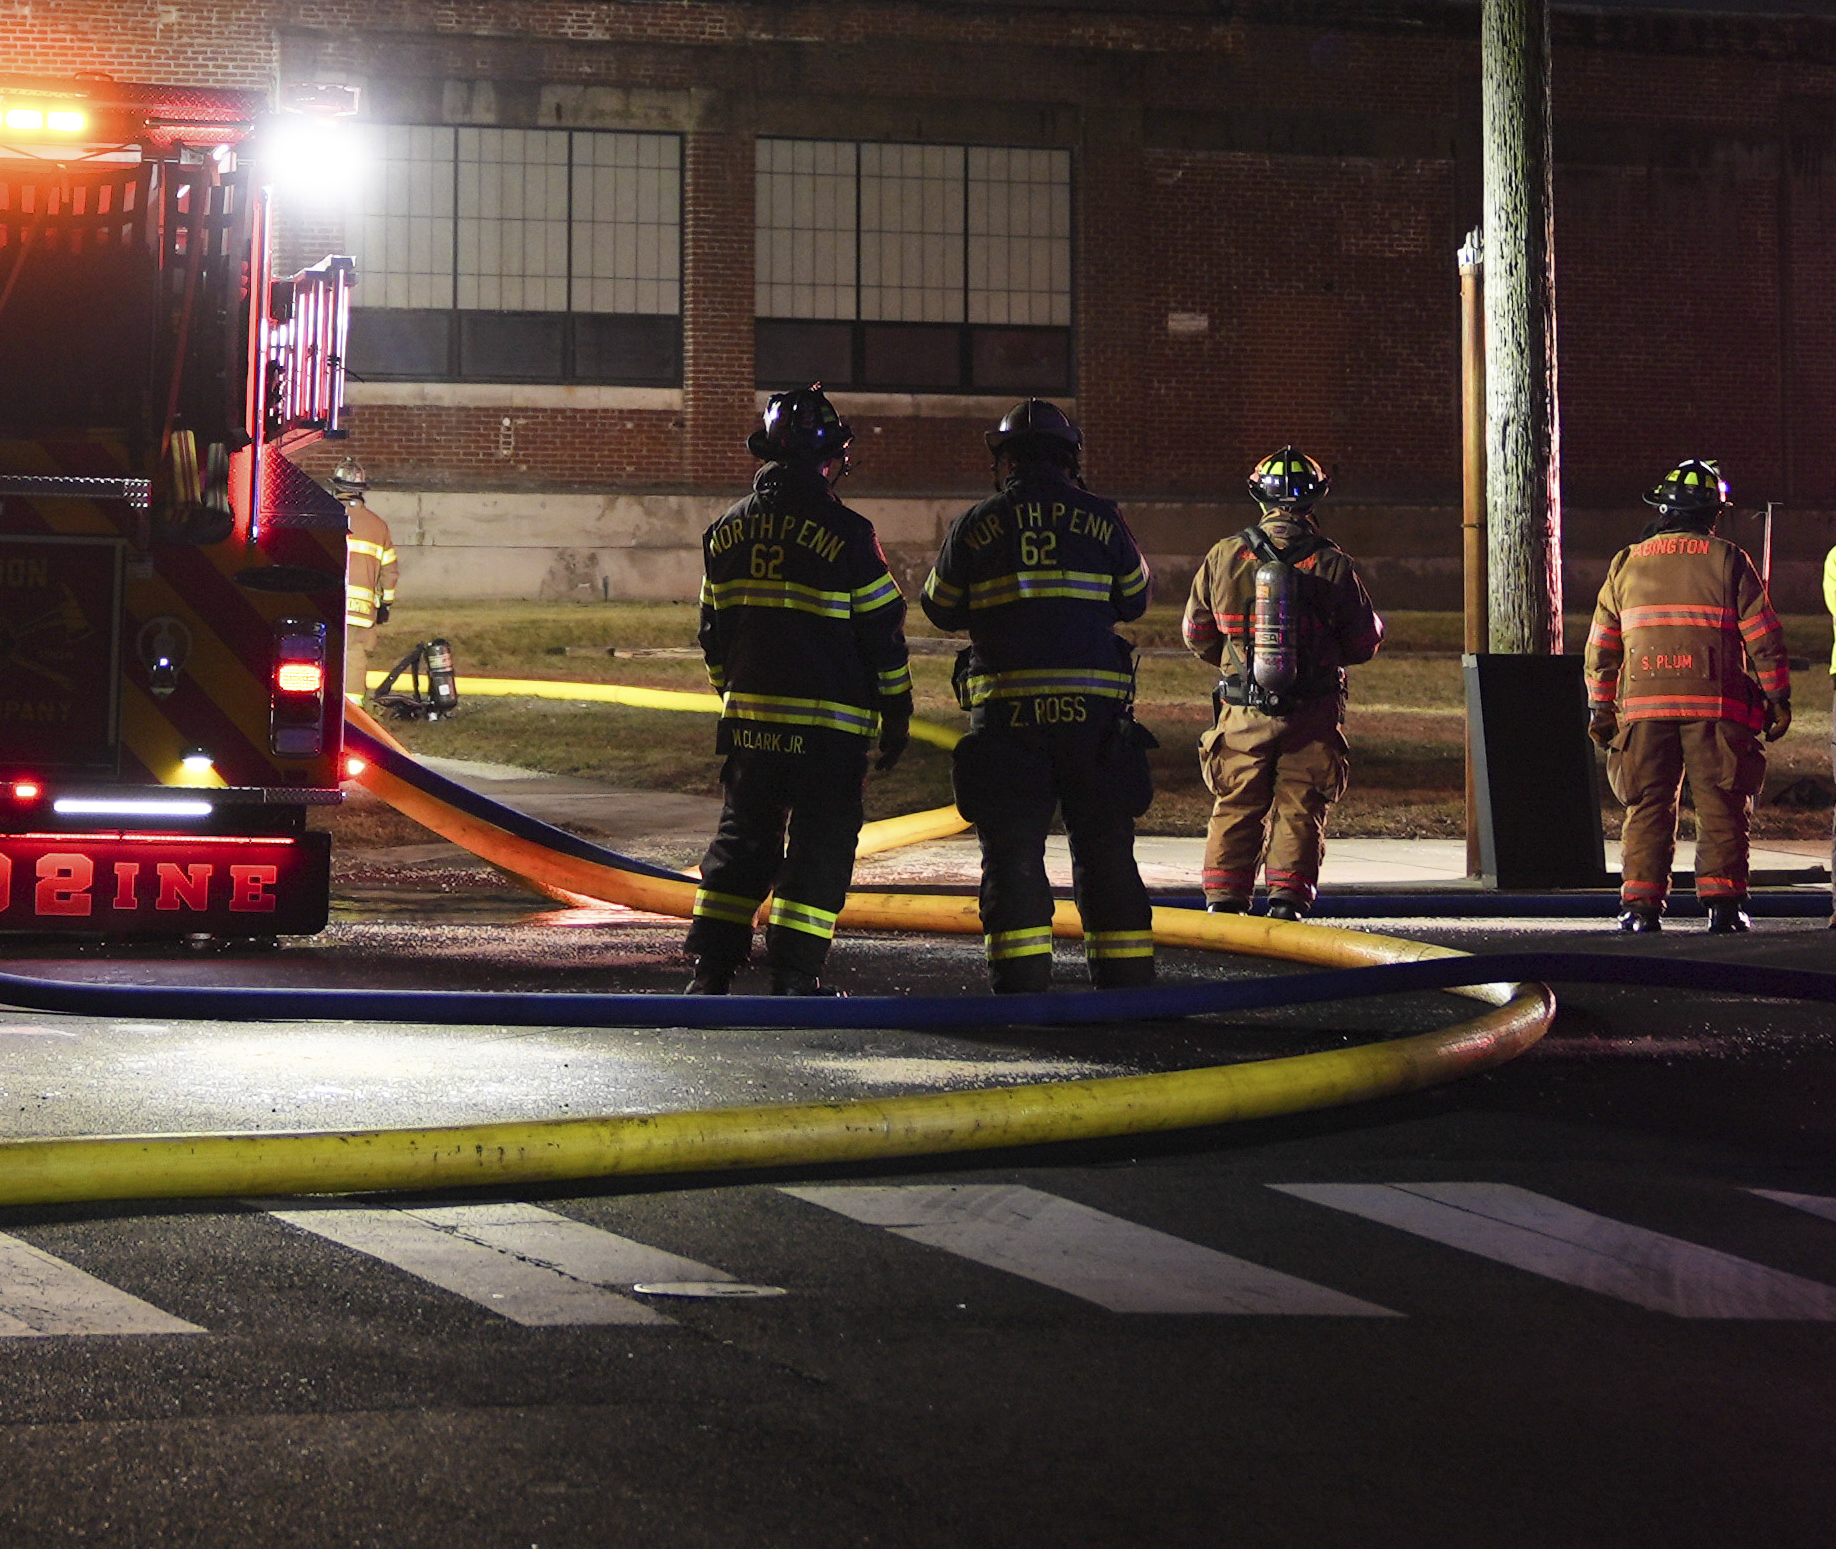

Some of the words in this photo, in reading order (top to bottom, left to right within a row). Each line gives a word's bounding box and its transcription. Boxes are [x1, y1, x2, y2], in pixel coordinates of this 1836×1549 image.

[710, 513, 774, 558] NORTH
[780, 514, 845, 563] PENN
[963, 502, 1043, 550] NORTH
[1052, 502, 1114, 546] PENN
[751, 543, 785, 579] 62
[1021, 531, 1058, 566] 62
[1630, 538, 1711, 558] ABINGTON
[1641, 656, 1654, 671] S.
[1656, 655, 1693, 669] PLUM
[1008, 700, 1029, 727] Z.
[1034, 696, 1087, 725] ROSS
[743, 730, 782, 752] CLARK
[784, 734, 807, 754] JR.
